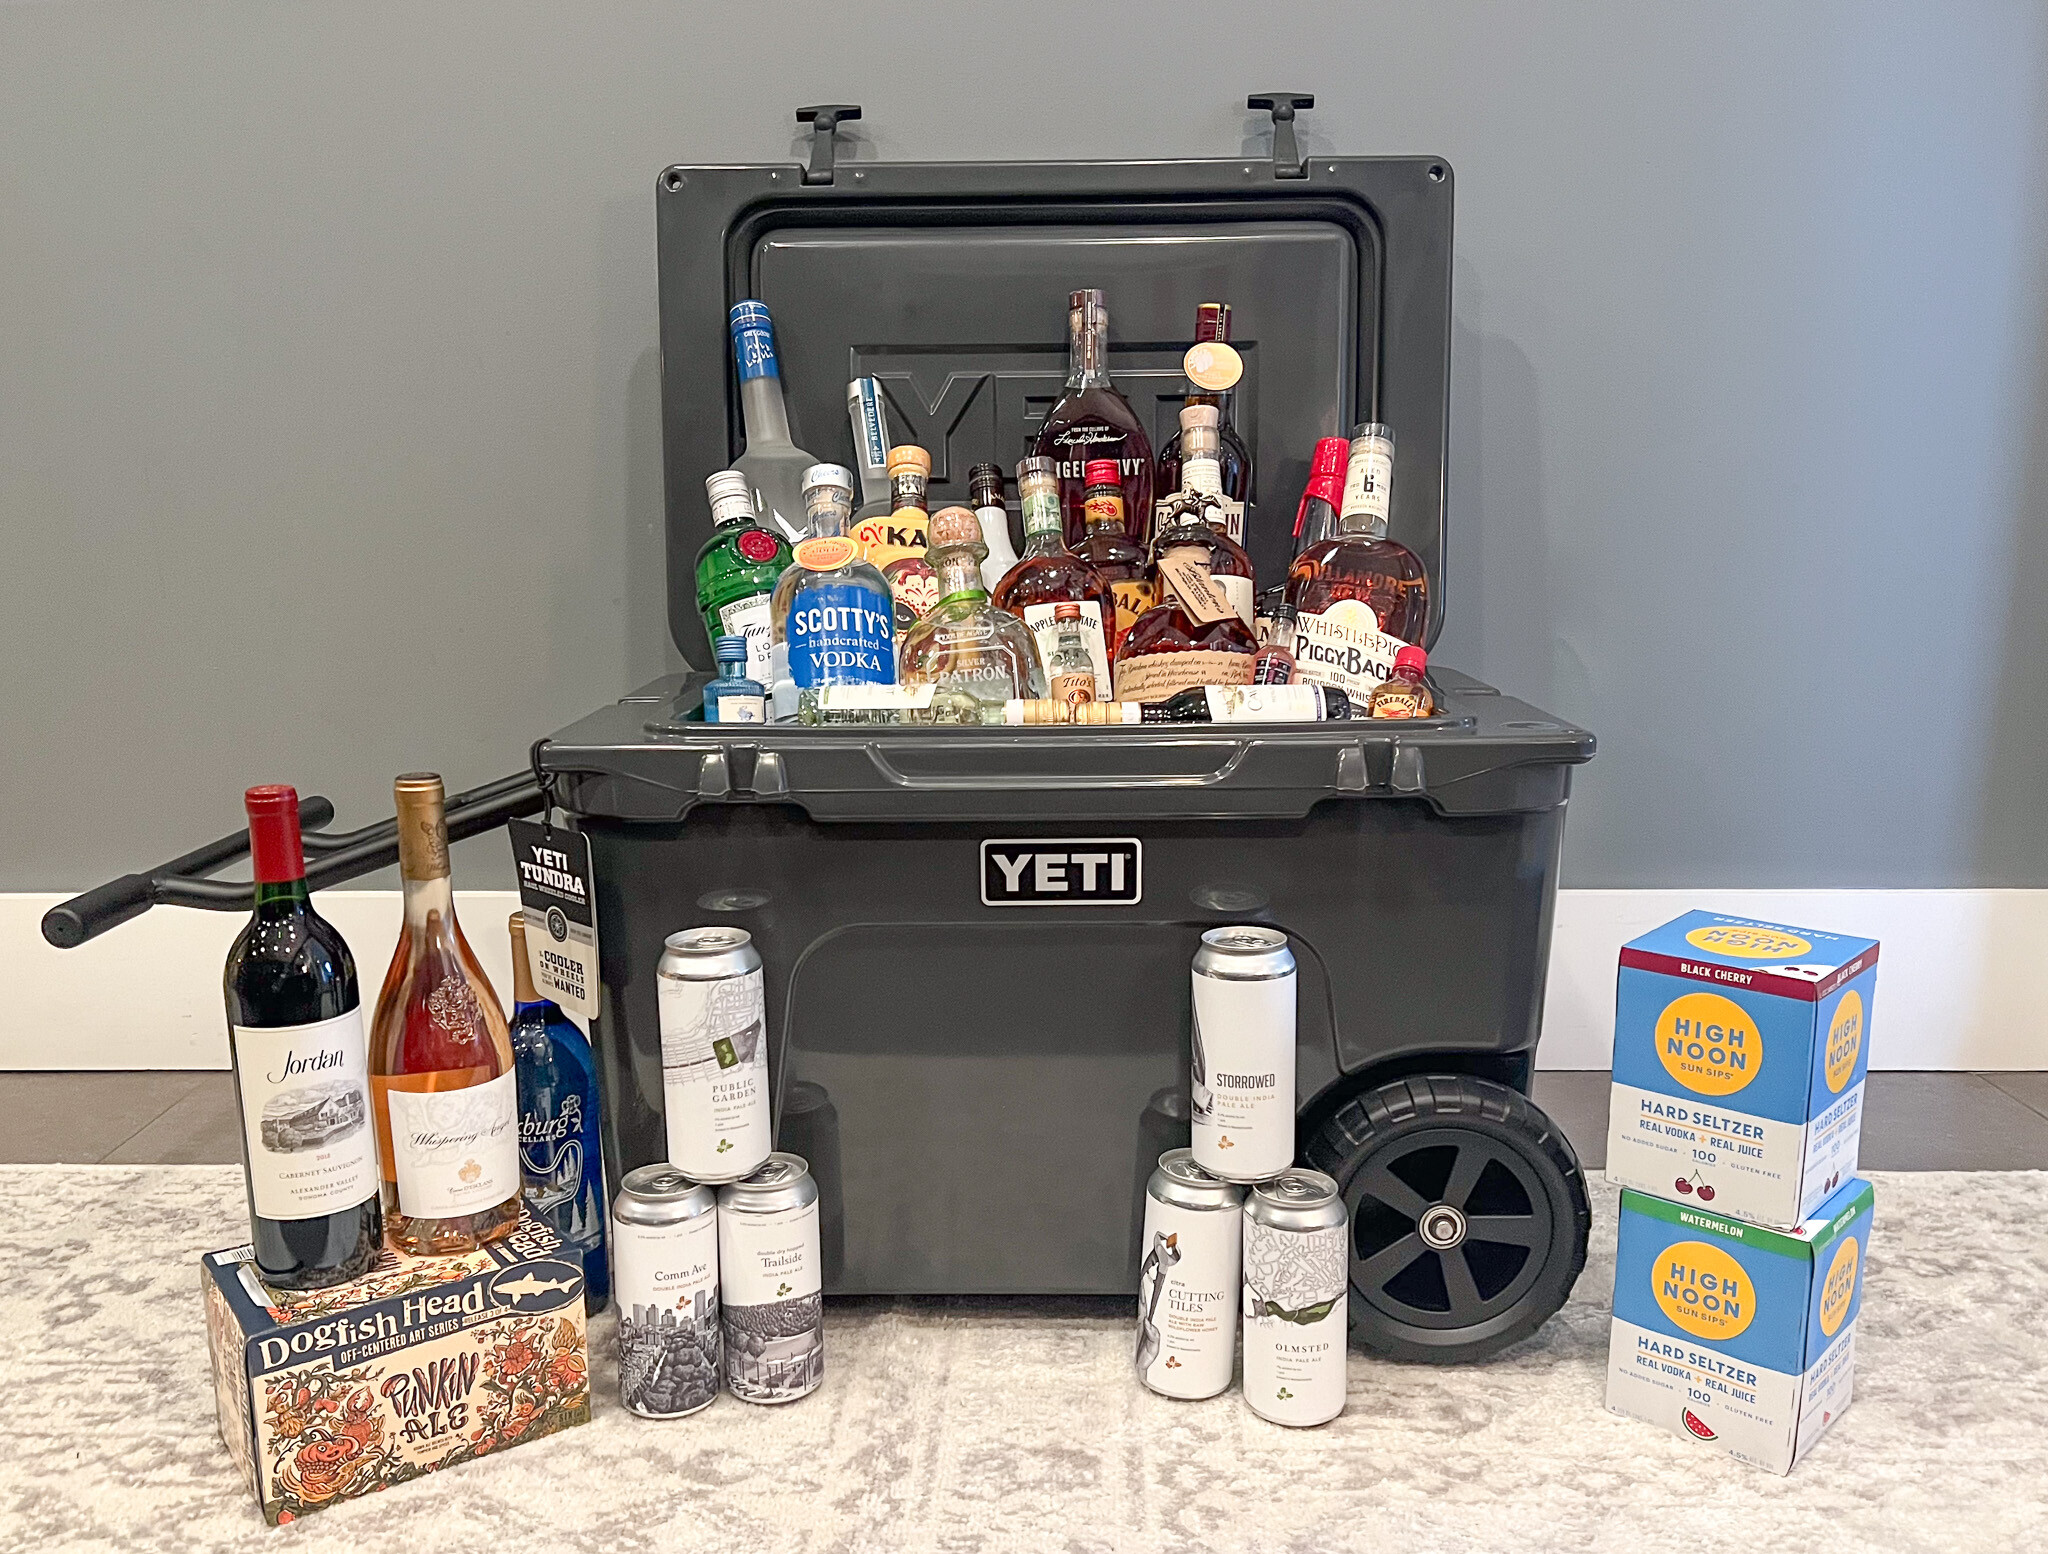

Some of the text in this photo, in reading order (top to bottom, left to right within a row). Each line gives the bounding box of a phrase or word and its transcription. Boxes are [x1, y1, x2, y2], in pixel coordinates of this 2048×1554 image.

[866, 396, 878, 441] BELVEDERE
[1364, 474, 1375, 492] 6
[887, 526, 928, 548] KA
[795, 607, 890, 639] SCOTTY'S
[809, 636, 879, 650] handcrafted
[810, 651, 882, 671] VODKA
[957, 657, 985, 667] SILVER
[1063, 676, 1092, 688] Tito's
[1330, 672, 1346, 683] 100
[1346, 688, 1370, 704] WHIS
[531, 845, 568, 871] YETI
[520, 861, 586, 896] TUNDRA
[991, 853, 1125, 891] YETI
[1704, 935, 1784, 953] HIGH
[1708, 930, 1798, 949] NOON
[540, 960, 584, 984] ON WHEELS
[544, 950, 584, 975] COOLER
[1680, 963, 1753, 985] BLACK CHERRY
[553, 976, 586, 1000] WANTED
[1674, 1016, 1744, 1048] HIGH
[1833, 1014, 1858, 1046] HIGH
[1667, 1037, 1746, 1071] NOON
[1829, 1036, 1857, 1069] NOON
[266, 1049, 344, 1084] Jordan
[1680, 1062, 1731, 1080] SUN SIPS
[712, 1078, 754, 1093] PUBLIC
[1216, 1073, 1275, 1089] STORROWED
[712, 1086, 756, 1103] GARDEN
[1217, 1093, 1249, 1102] DOUBLE
[1217, 1101, 1236, 1109] PALE
[518, 1112, 569, 1138] burg
[1641, 1099, 1764, 1141] HARD SELTZER
[1814, 1093, 1857, 1135] HARD SELTZER
[410, 1110, 513, 1150] Whispering Angel
[518, 1134, 557, 1143] CELLARS
[1639, 1119, 1763, 1159] REAL VODKA REAL JUICE
[1632, 1137, 1655, 1147] ADDED
[1656, 1142, 1678, 1153] SUGAR
[1692, 1149, 1717, 1163] 100
[278, 1156, 364, 1180] CABERNET SAUVIGNON
[1730, 1163, 1782, 1180] GLUTEN FREE
[290, 1174, 359, 1195] ALEXANDER VALLEY
[298, 1192, 327, 1201] SONOMA
[1680, 1211, 1744, 1238] WATERMELON
[508, 1228, 553, 1260] ead
[760, 1252, 802, 1268] Trailside
[654, 1263, 707, 1281] Comm Ave
[1170, 1279, 1186, 1287] citra
[1670, 1262, 1738, 1298] HIGH
[1828, 1256, 1853, 1294] HIGH
[1168, 1289, 1225, 1301] CUTTING
[1663, 1281, 1740, 1319] NOON
[1824, 1275, 1851, 1315] NOON
[1168, 1300, 1203, 1313] TILES
[1676, 1305, 1726, 1326] SUN SIPS
[258, 1281, 485, 1370] Dogfish Head
[340, 1318, 460, 1365] OFF-CENTERED ART SERIES
[1275, 1342, 1329, 1353] OLMSTED
[1638, 1336, 1757, 1387] HARD SELTZER
[1810, 1357, 1828, 1386] HARD
[1618, 1367, 1674, 1390] NO ADDED SUGAR
[1636, 1355, 1757, 1404] REAL VODKA REAL JUICE
[1687, 1387, 1711, 1403] 100
[399, 1402, 469, 1443] ALE
[1724, 1404, 1774, 1426] GLUTEN FREE
